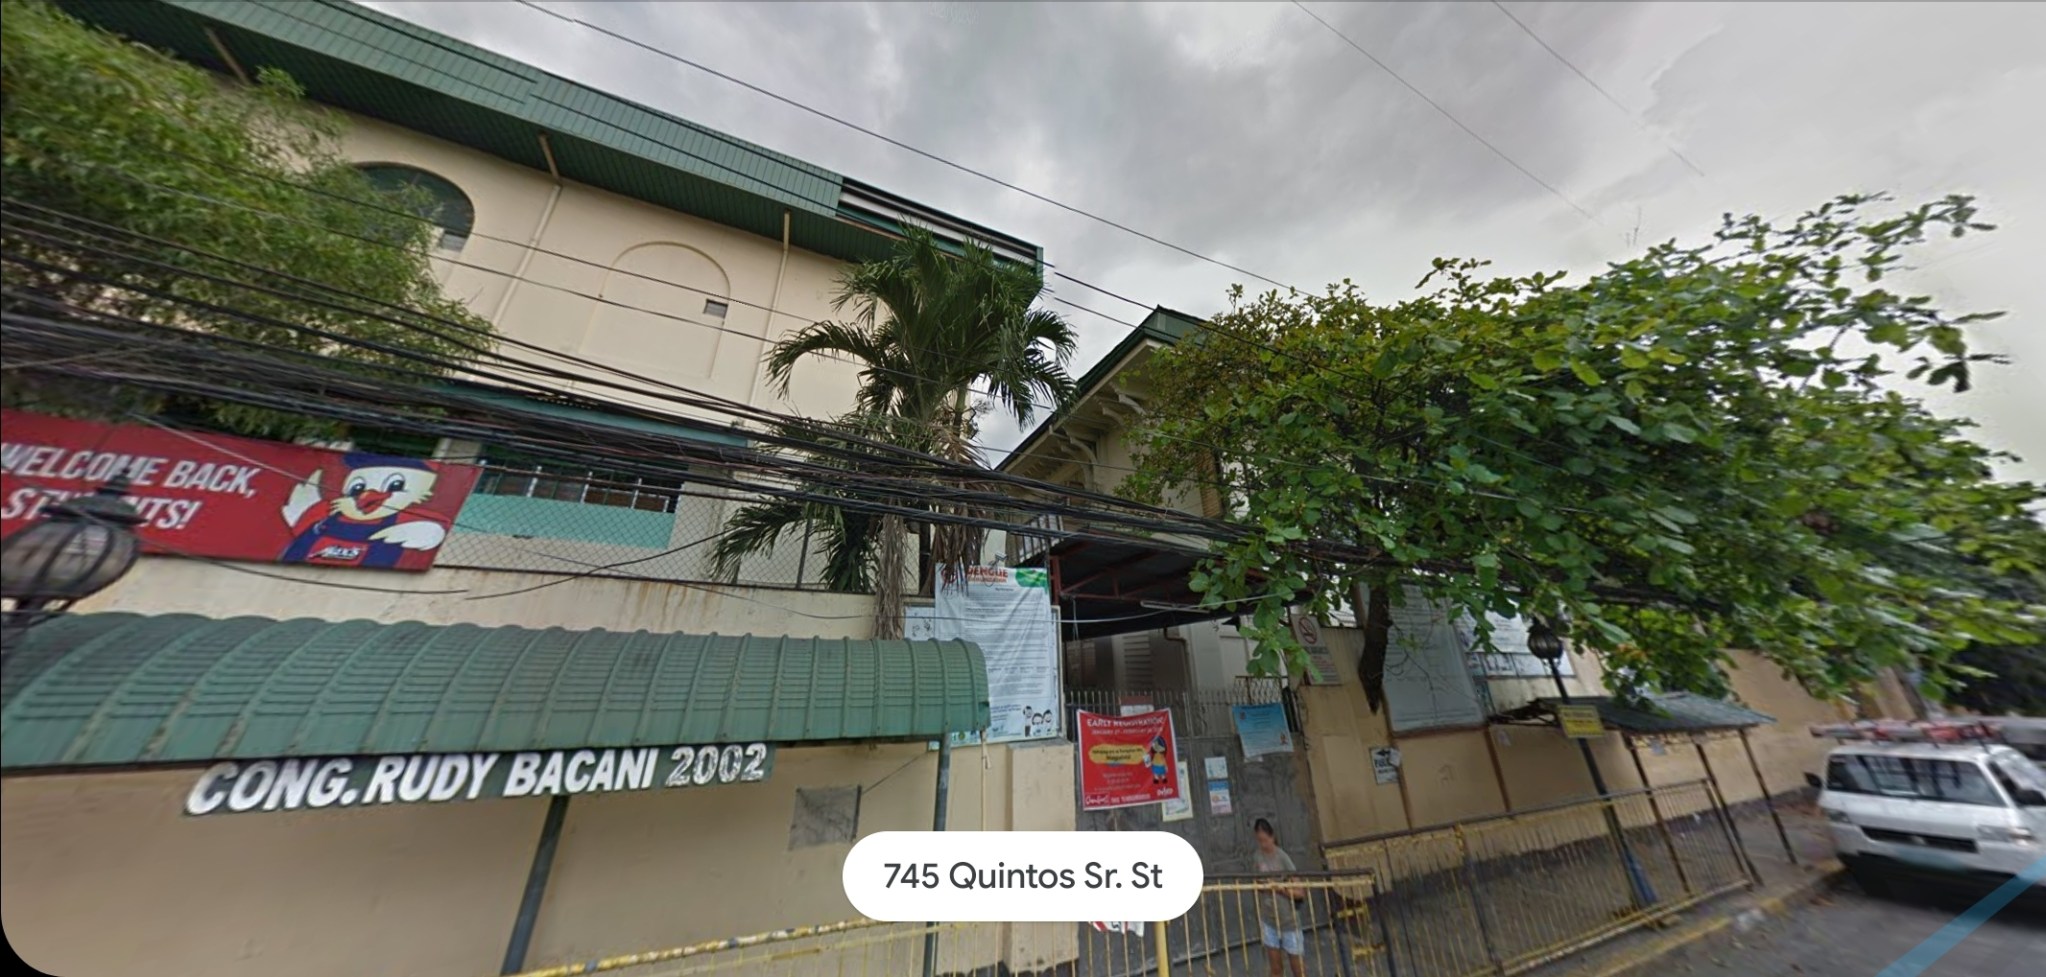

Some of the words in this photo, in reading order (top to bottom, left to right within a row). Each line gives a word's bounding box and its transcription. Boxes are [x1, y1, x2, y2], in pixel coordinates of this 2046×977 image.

[0, 442, 169, 486] WELCOME
[163, 460, 260, 498] BACK,
[187, 760, 357, 815] CONG.
[362, 755, 496, 803] RUDY
[502, 748, 659, 797] BACANI
[667, 743, 767, 787] 2002
